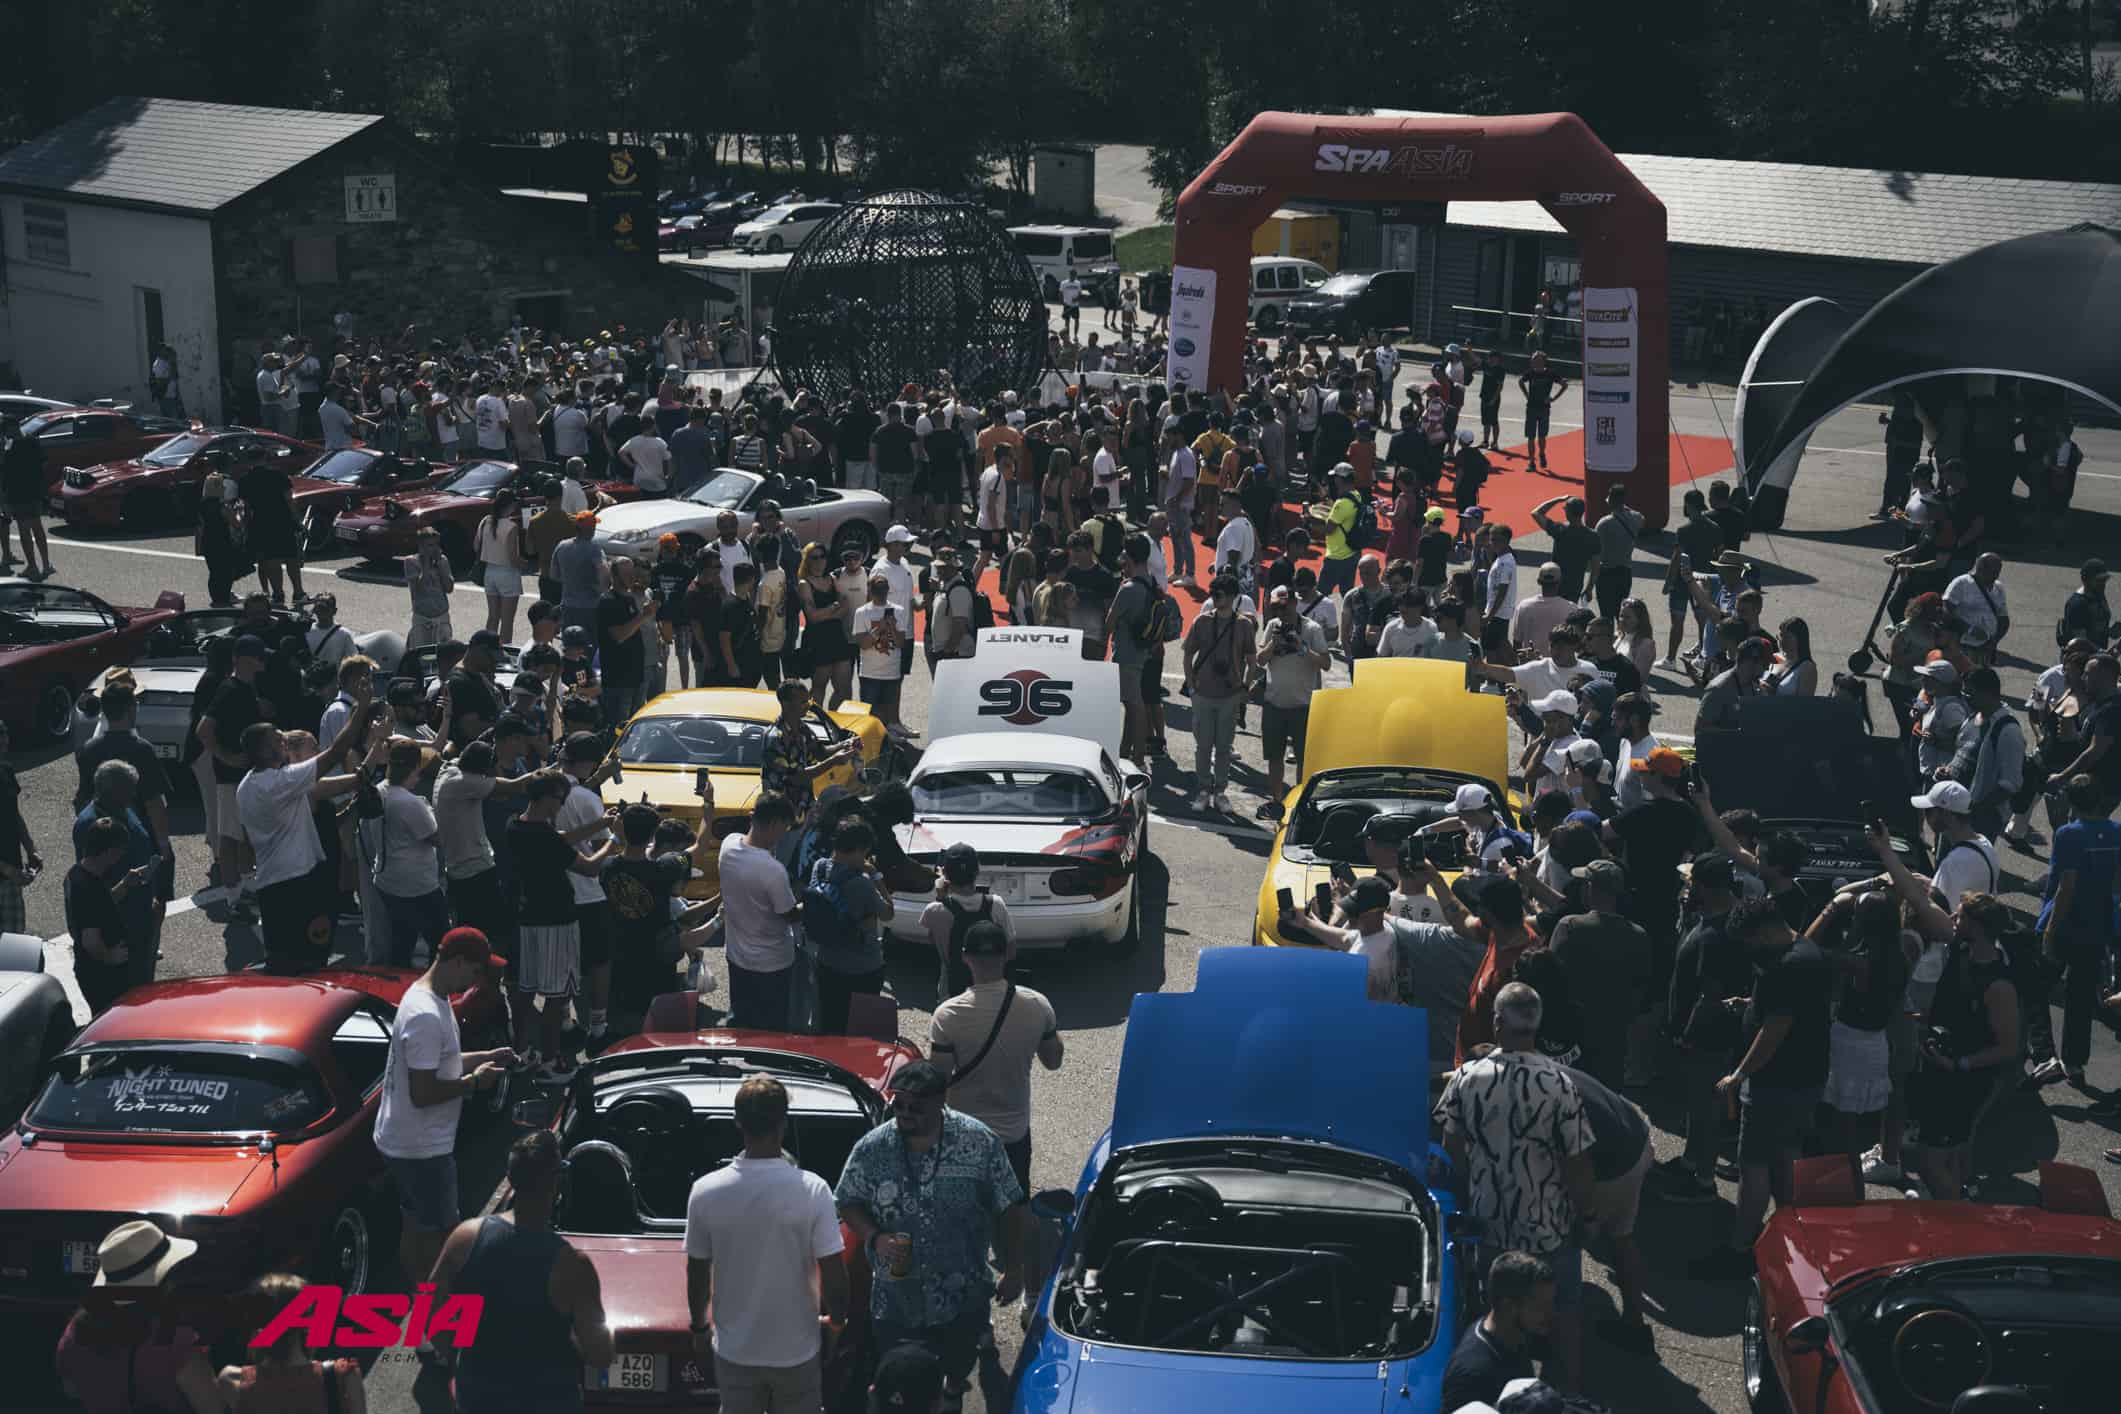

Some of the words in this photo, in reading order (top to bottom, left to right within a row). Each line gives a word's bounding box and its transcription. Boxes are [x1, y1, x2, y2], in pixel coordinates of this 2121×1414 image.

[1314, 144, 1393, 173] SPA
[360, 178, 377, 186] WC
[1215, 182, 1267, 195] SPORT
[1559, 192, 1617, 204] SPORT
[986, 634, 1068, 644] PLANET
[978, 679, 1073, 716] 96
[107, 1078, 166, 1099] NIGHT
[168, 1079, 229, 1101] TUNED
[621, 1373, 652, 1387] 586
